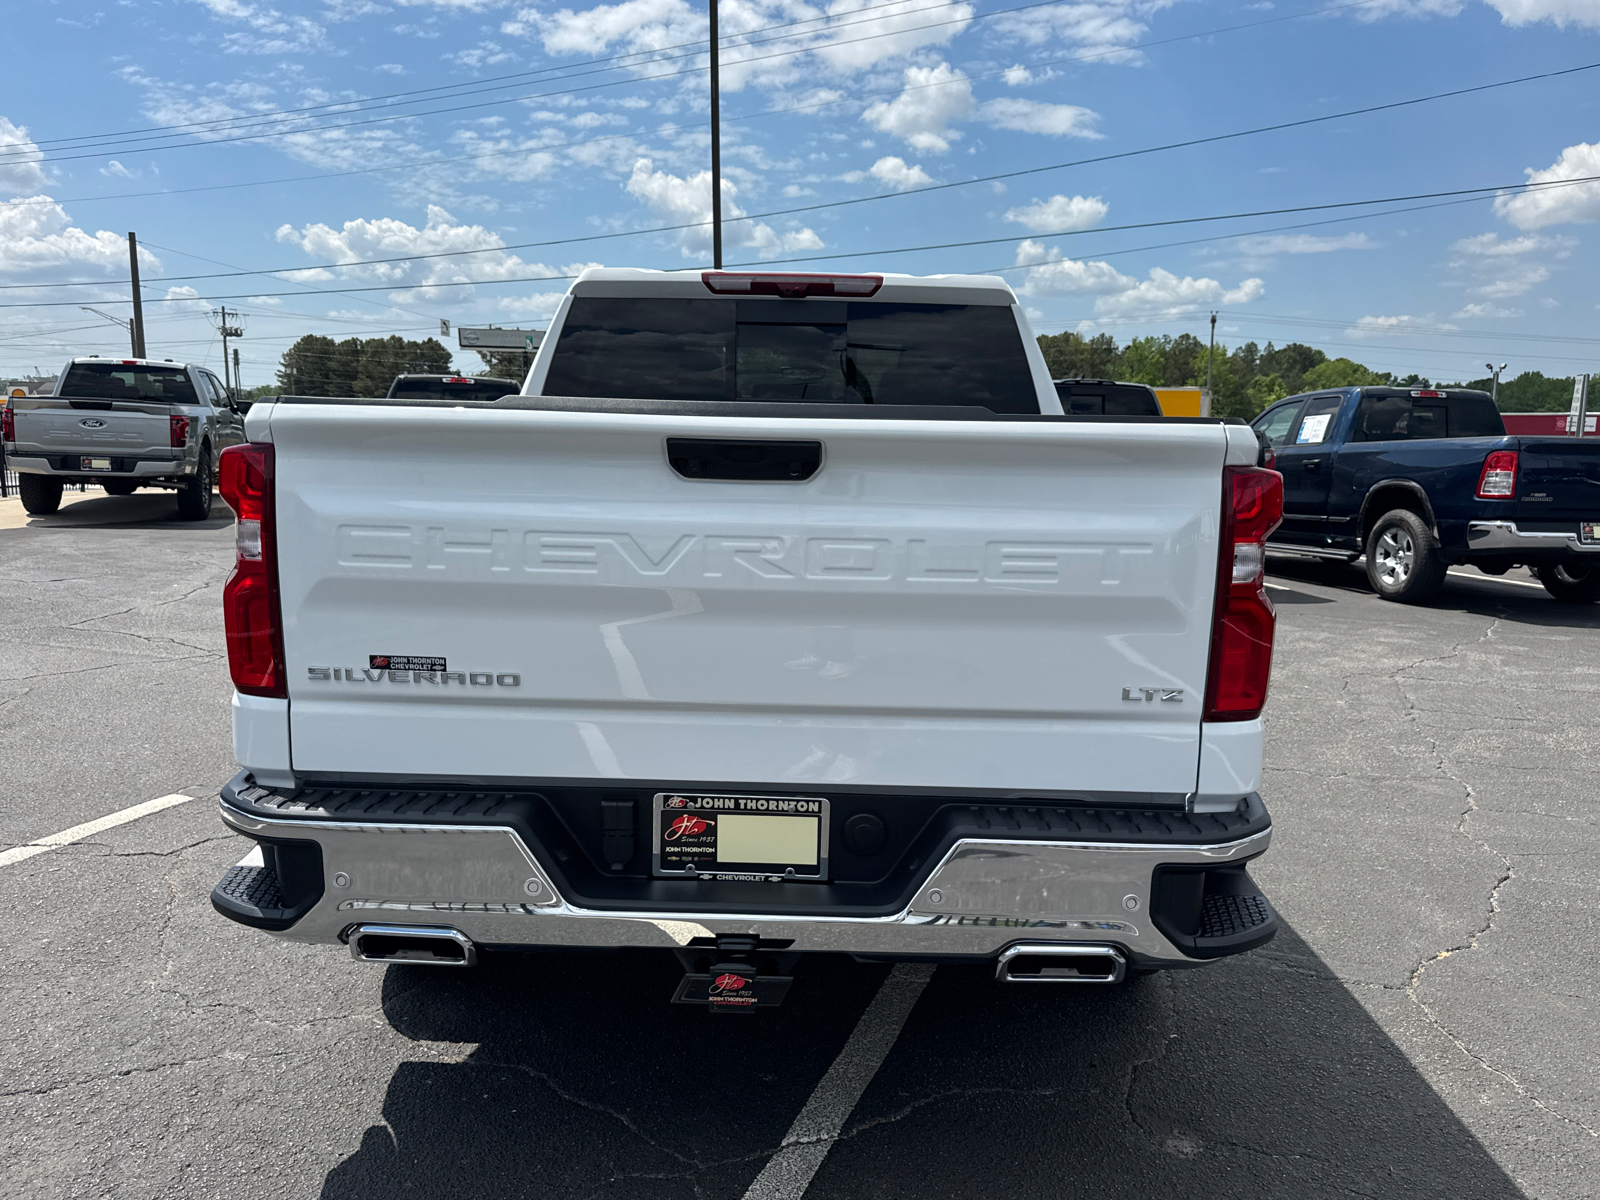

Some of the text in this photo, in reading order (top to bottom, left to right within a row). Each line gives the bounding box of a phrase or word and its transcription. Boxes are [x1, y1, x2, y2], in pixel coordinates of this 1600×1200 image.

[336, 524, 1154, 586] CHEVROLET
[408, 657, 445, 665] THORNTON
[307, 665, 521, 687] SILVERADO
[1121, 686, 1184, 702] LTZ
[695, 797, 735, 809] JOHN
[738, 799, 819, 812] THORNTON
[716, 874, 766, 882] CHEVROLET
